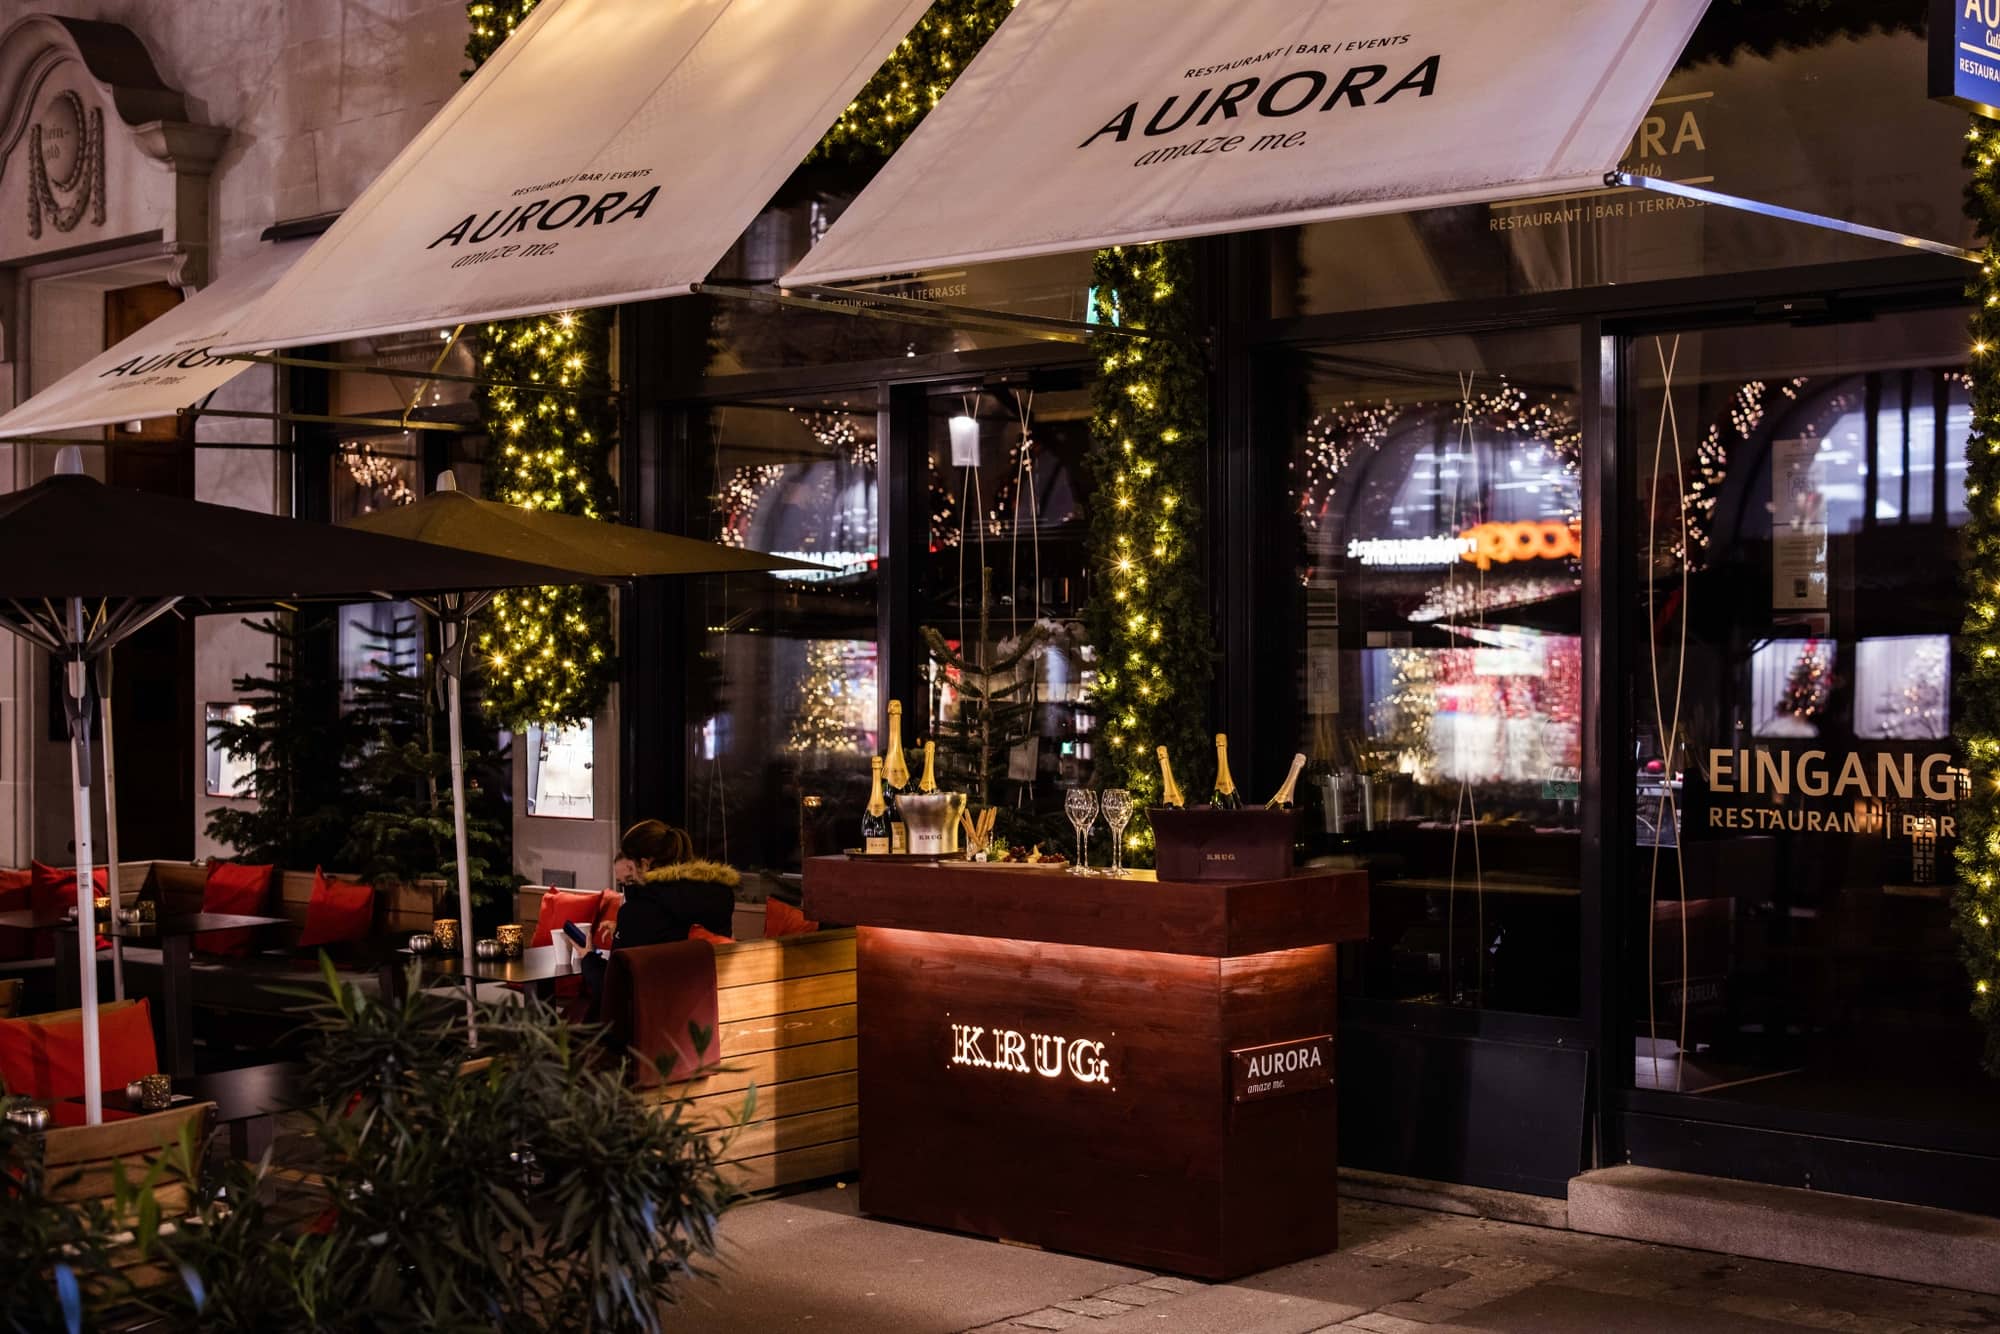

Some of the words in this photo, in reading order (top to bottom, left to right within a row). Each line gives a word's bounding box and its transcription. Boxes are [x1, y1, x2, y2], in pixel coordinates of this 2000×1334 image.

[1184, 48, 1284, 79] RESTAURANT
[1296, 44, 1331, 54] BAR
[1345, 34, 1412, 51] EVENTS
[1959, 57, 2000, 82] RESTAURA
[1077, 54, 1441, 149] AURORA
[1133, 135, 1245, 168] amaze
[1248, 131, 1307, 152] me.
[1620, 111, 1706, 161] RA
[512, 177, 574, 197] RESTAURANT
[578, 173, 602, 182] BAR
[609, 169, 653, 180] EVENTS
[426, 185, 661, 249] AURORA
[1489, 207, 1581, 231] RESTAURANT
[1596, 203, 1624, 218] BAR
[1638, 196, 1712, 213] TERRASS
[451, 244, 521, 269] amaze
[521, 242, 560, 256] me.
[917, 284, 967, 300] TERRASSE
[1709, 749, 1956, 801] EINGANG
[1709, 807, 1872, 834] RESTAURANT
[1902, 813, 1956, 838] BAR
[952, 1024, 1110, 1084] KRUG
[1247, 1046, 1322, 1079] AURORA
[1247, 1081, 1271, 1094] amaze
[1272, 1080, 1285, 1089] me.
